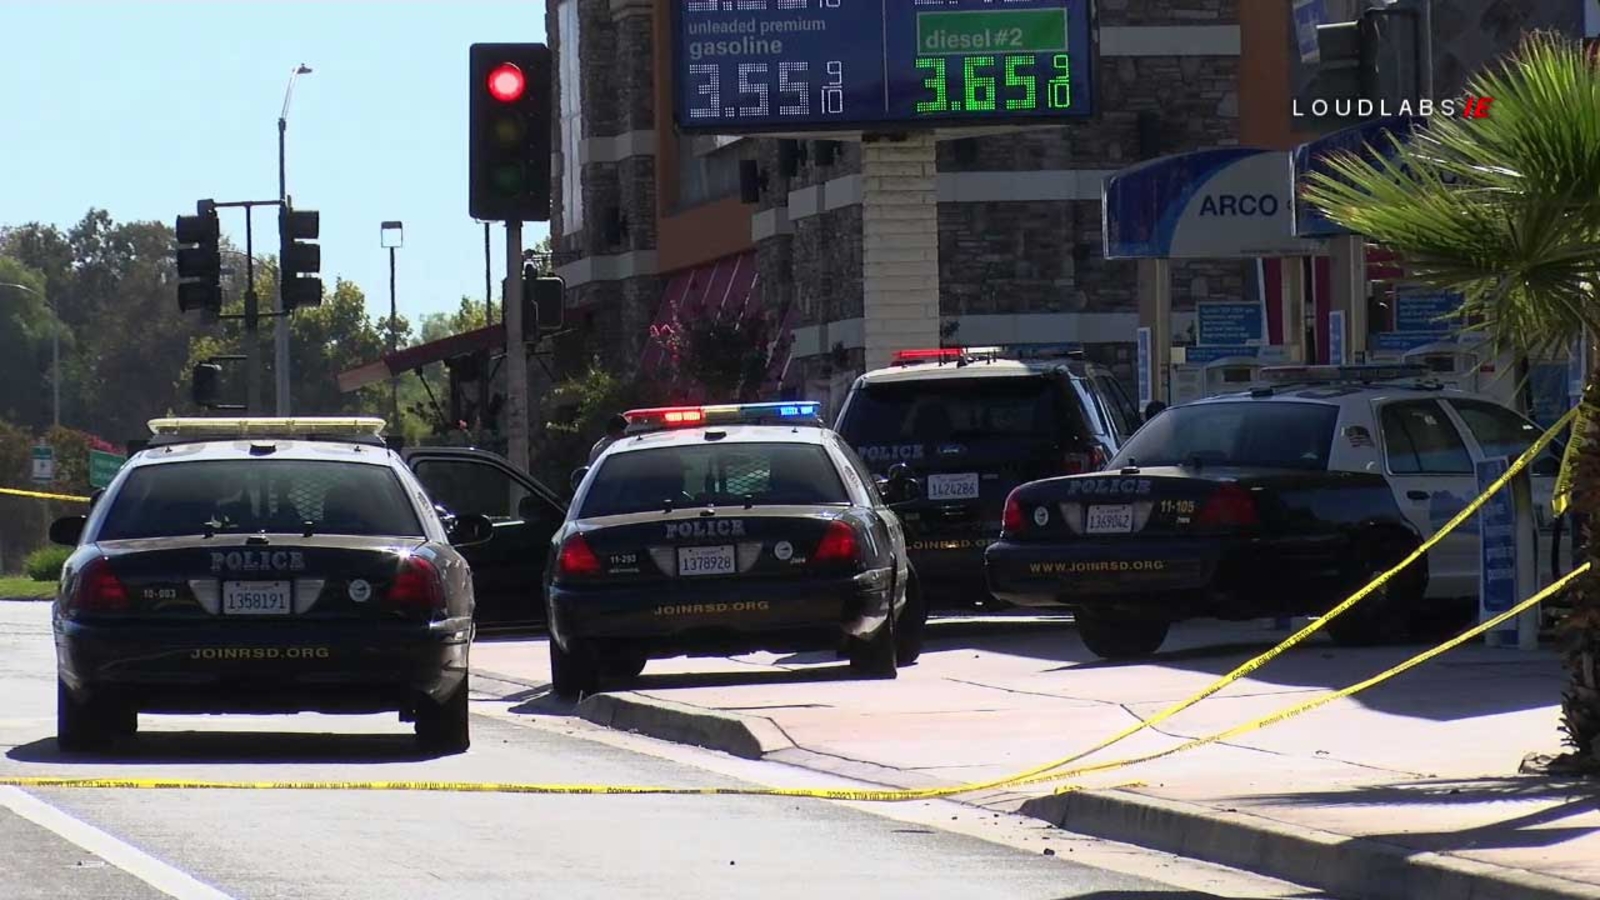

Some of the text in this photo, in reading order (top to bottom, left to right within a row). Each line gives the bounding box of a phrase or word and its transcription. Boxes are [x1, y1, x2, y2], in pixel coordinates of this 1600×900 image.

[688, 17, 826, 35] unleaded premium
[925, 29, 991, 48] diesel
[689, 36, 783, 60] gasoline
[689, 62, 810, 118] 3.55
[915, 54, 1036, 112] 3.65
[1200, 194, 1278, 217] ARCO
[858, 444, 923, 460] POLICE
[1067, 479, 1151, 495] POLICE
[1160, 500, 1195, 513] 11-105
[664, 520, 747, 539] POLICE
[209, 551, 306, 570] POLICE
[682, 552, 731, 571] 1378928
[1029, 560, 1164, 573] WWW.JOINRSD.ORG
[228, 592, 286, 610] 1358191
[654, 600, 770, 616] JOINRSD.ORG
[190, 647, 330, 660] JOINRSD.ORG
